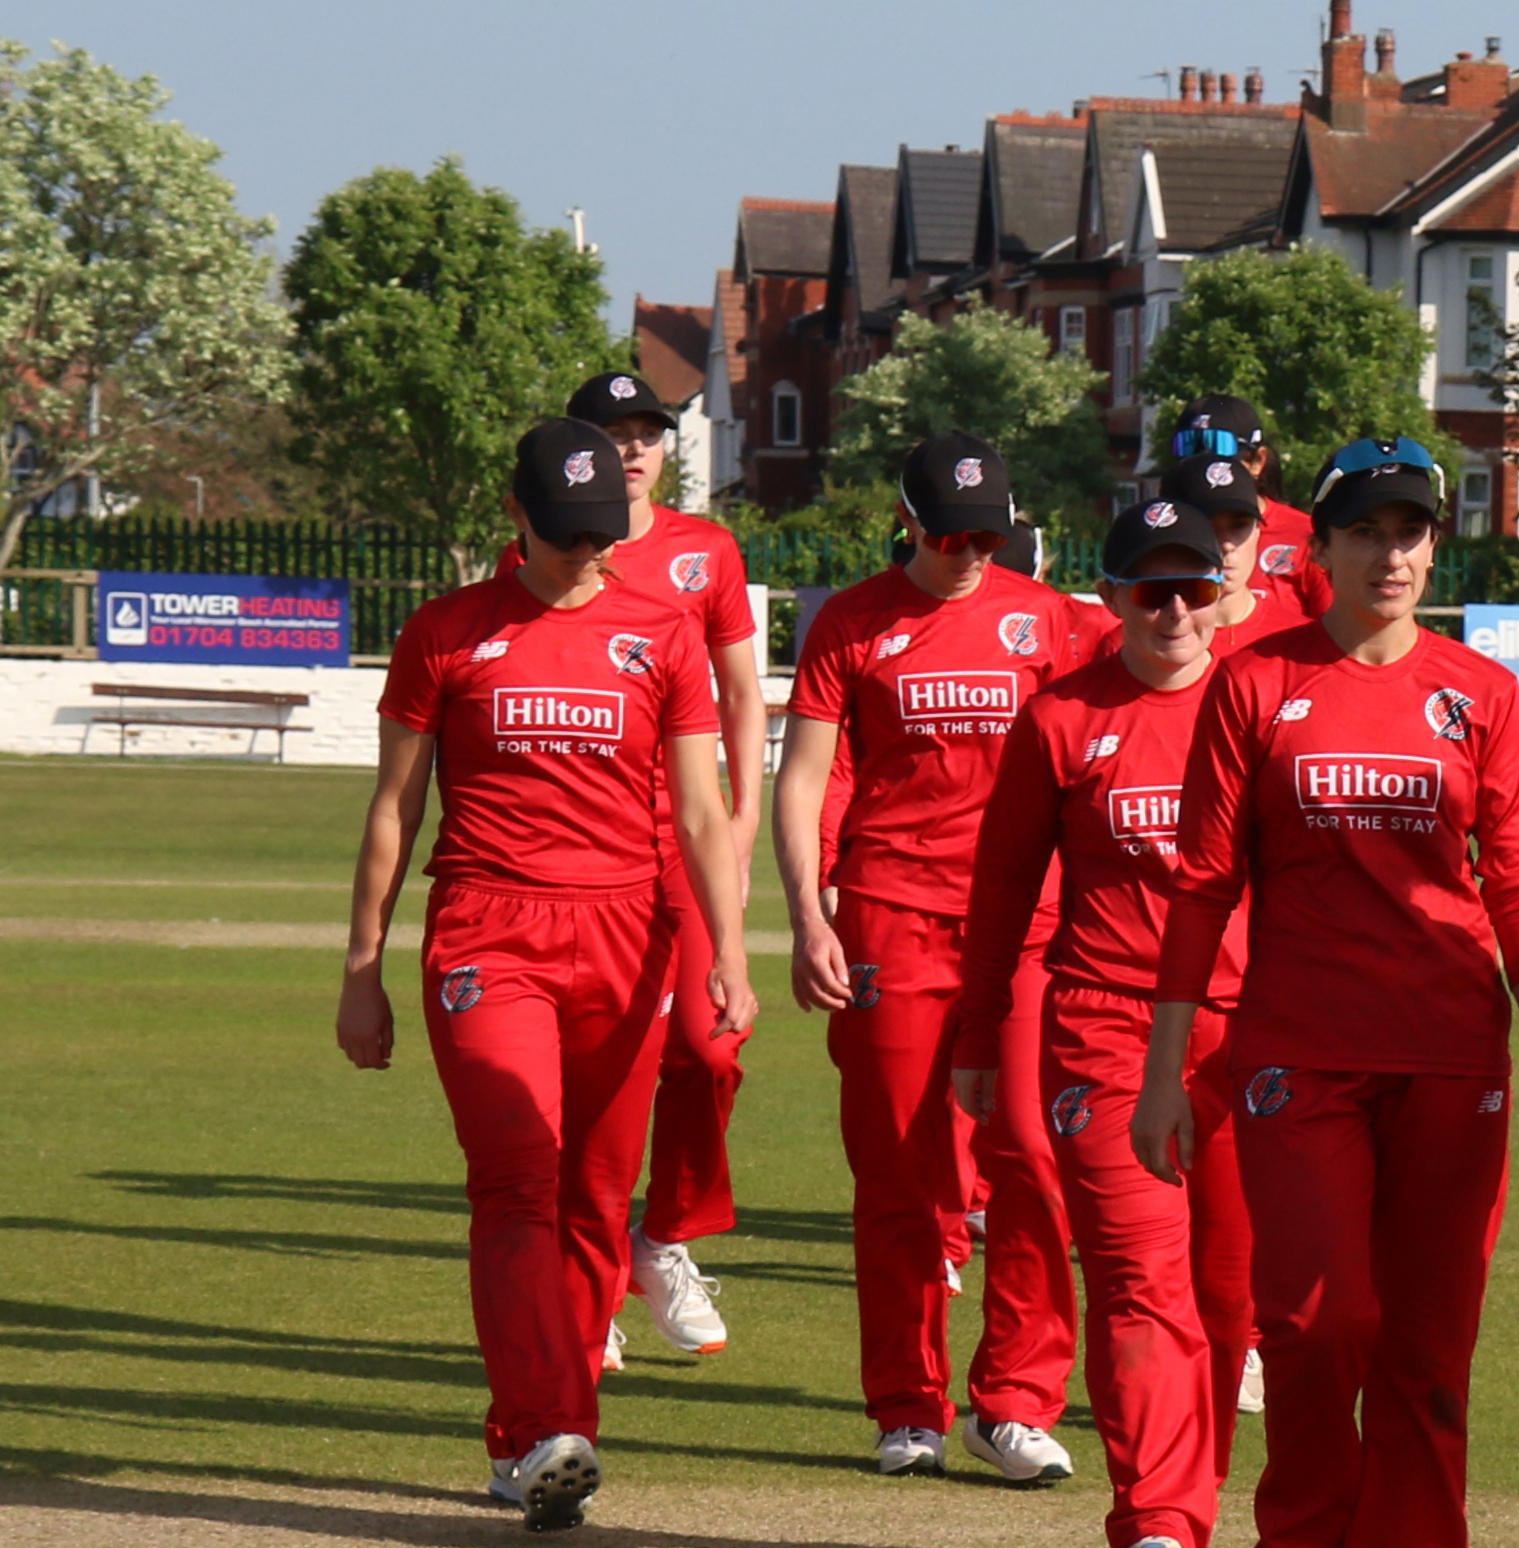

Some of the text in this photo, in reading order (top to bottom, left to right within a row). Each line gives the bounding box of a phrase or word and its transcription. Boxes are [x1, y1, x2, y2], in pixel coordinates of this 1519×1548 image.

[151, 626, 340, 650] 01704 834363
[909, 681, 1009, 710] Hilton
[504, 697, 614, 729] Hilton
[905, 723, 937, 735] FOR
[942, 722, 973, 734] THE
[497, 740, 617, 758] FOR THE STAY
[1308, 763, 1429, 800] Hilton
[1120, 796, 1181, 828] Hilt
[1305, 815, 1437, 834] FOR THE STAY
[1156, 841, 1177, 855] TH
